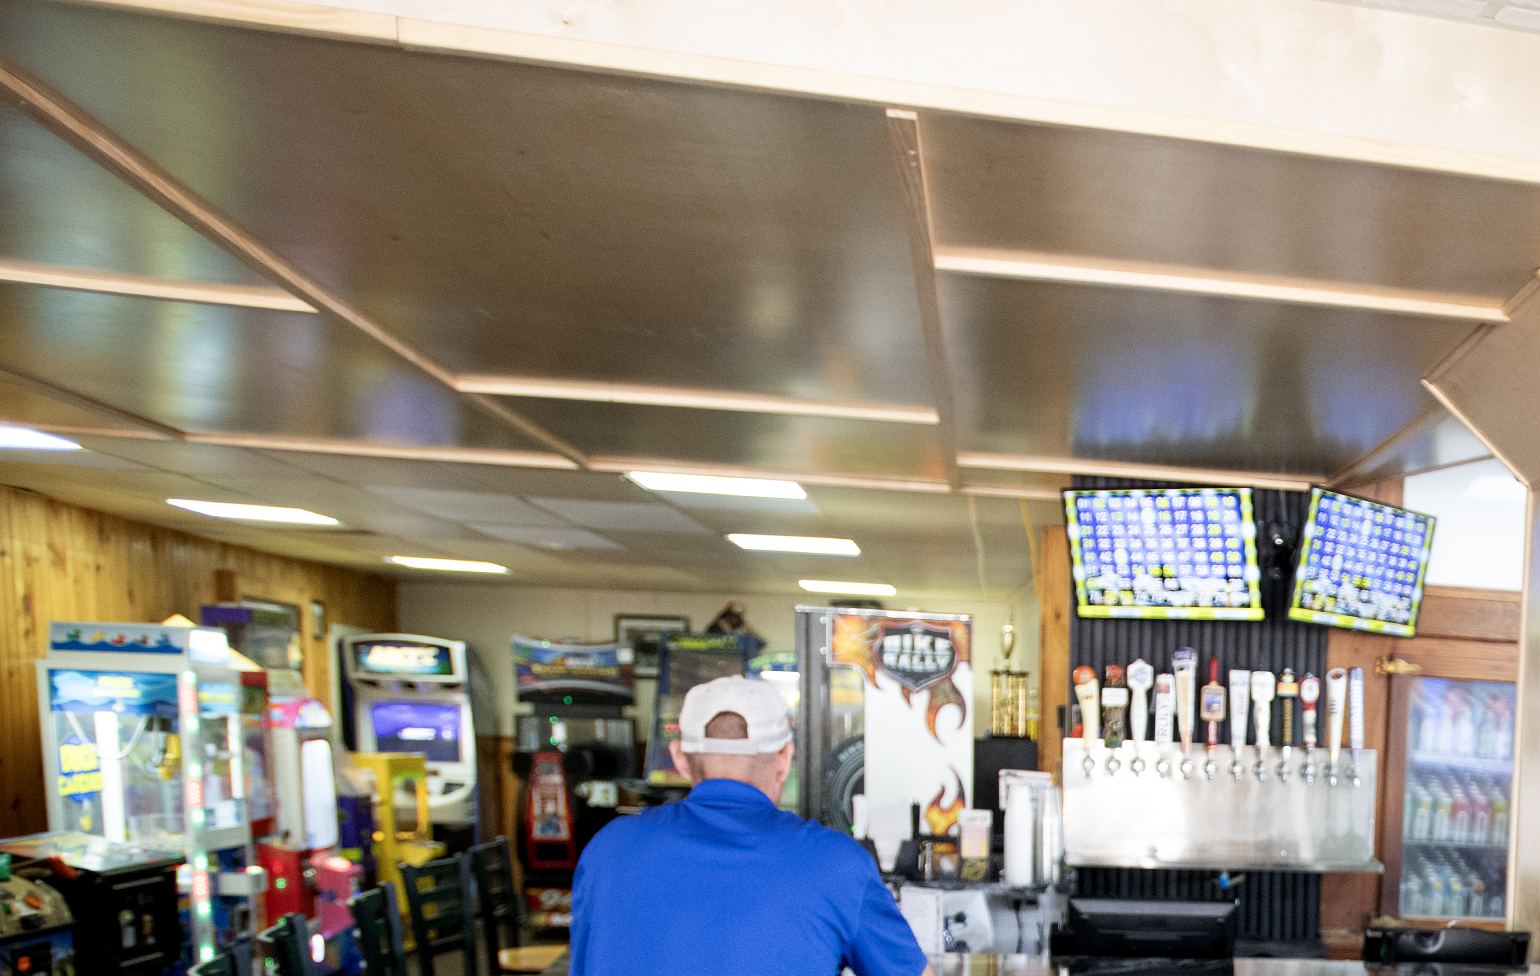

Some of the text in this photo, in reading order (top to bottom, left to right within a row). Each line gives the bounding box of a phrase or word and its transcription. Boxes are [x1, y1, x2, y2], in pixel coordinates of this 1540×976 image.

[884, 633, 951, 654] BIKE
[883, 653, 950, 673] RALLY
[1157, 702, 1168, 747] TRULY
